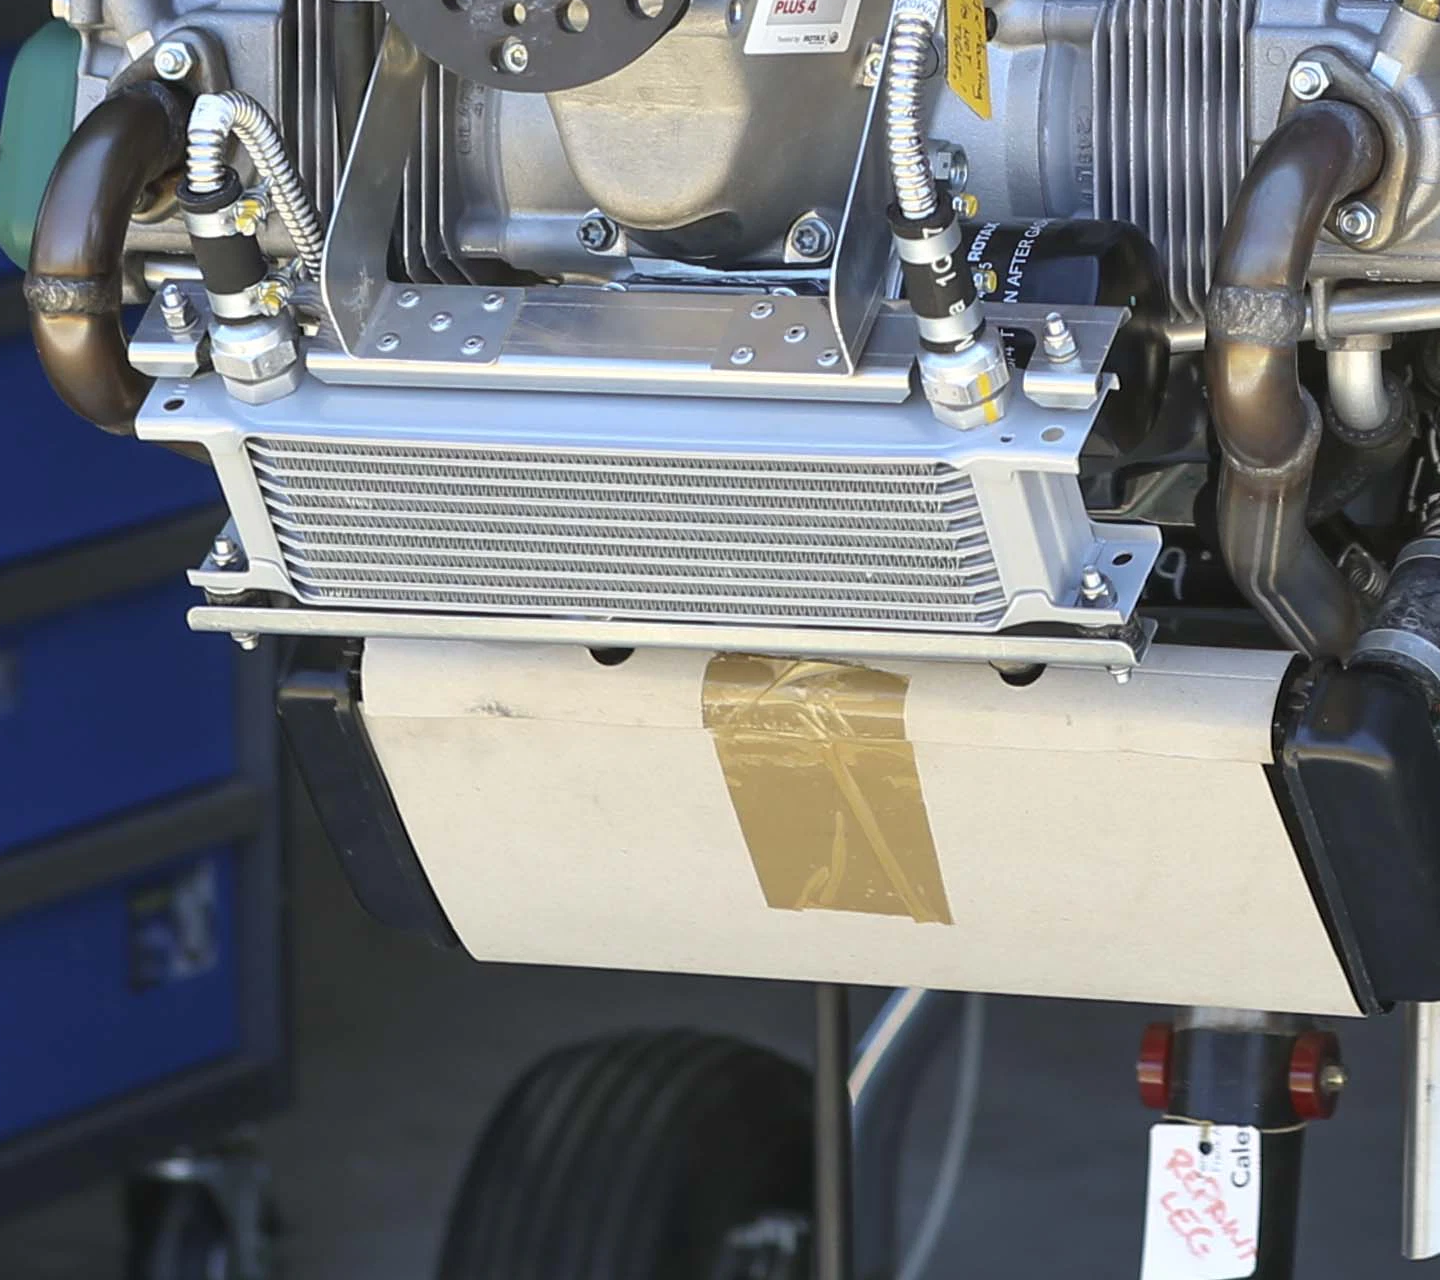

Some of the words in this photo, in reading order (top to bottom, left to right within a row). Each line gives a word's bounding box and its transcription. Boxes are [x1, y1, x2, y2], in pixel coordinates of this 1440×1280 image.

[774, 0, 806, 15] PLUS
[807, 0, 817, 14] 4
[967, 222, 1001, 262] ROTAX
[1007, 238, 1035, 287] AFTER
[1160, 1192, 1215, 1259] LEG
